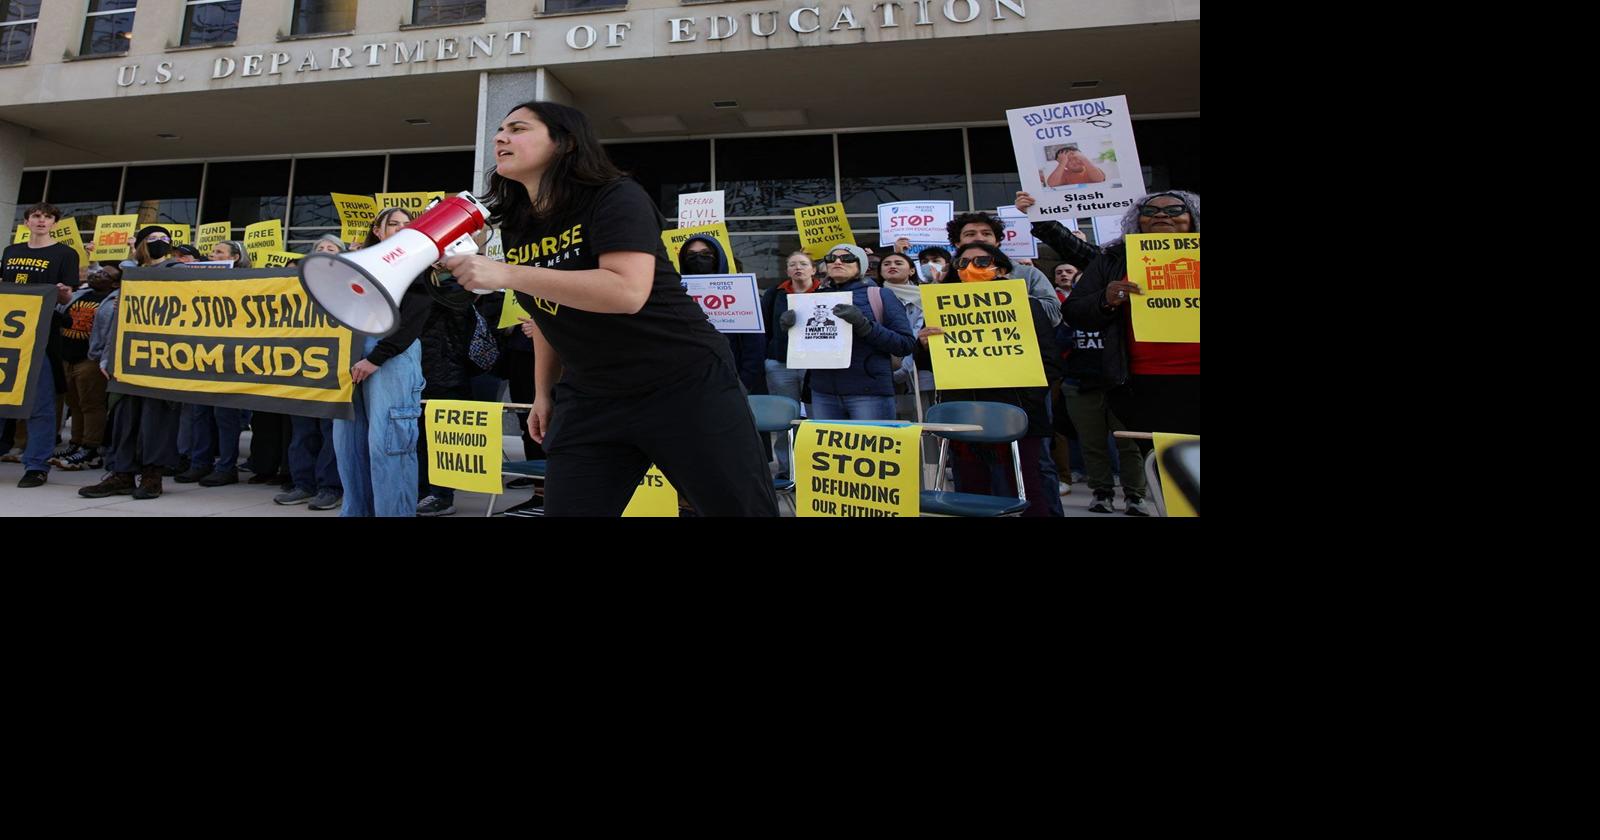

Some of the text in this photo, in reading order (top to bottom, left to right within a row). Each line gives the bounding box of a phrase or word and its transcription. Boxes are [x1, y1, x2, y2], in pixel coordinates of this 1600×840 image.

[117, 0, 1027, 88] U.S. DEPARTMENT OF EDUCATION
[1023, 100, 1106, 127] EDUCATION
[1035, 125, 1073, 140] CUTS
[382, 197, 422, 208] FUND
[1064, 191, 1104, 202] Slash
[1077, 198, 1134, 212] futures!
[343, 211, 375, 219] STOP
[680, 208, 718, 220] CIVIL
[800, 206, 836, 218] FUND
[803, 215, 840, 227] EDUCATION
[889, 215, 934, 228] STOP
[48, 227, 72, 239] REE
[201, 226, 226, 235] FUND
[248, 228, 275, 239] FREE
[805, 224, 843, 237] NOT 1%
[671, 234, 688, 243] KIDS
[807, 233, 846, 244] TAX CUTS
[1140, 239, 1171, 251] KIDS
[7, 257, 50, 269] SUNRISE
[534, 248, 581, 267] EMENT
[936, 291, 1013, 310] FUND
[1147, 297, 1181, 309] GOOD
[124, 294, 188, 328] TRUMP:
[192, 295, 239, 328] STOP
[940, 309, 1017, 328] EDUCATION
[943, 326, 1022, 345] NOT 1%
[1073, 329, 1101, 338] EW
[1074, 339, 1105, 349] EAL
[946, 344, 1024, 358] TAX CUTS
[128, 338, 330, 380] FROM KIDS
[434, 408, 489, 428] FREE
[434, 430, 487, 448] MAHMOUD
[815, 428, 902, 455] TRUMP:
[436, 450, 488, 475] KHALIL
[812, 451, 900, 480] STOP
[811, 476, 900, 506] DEFUNDING
[811, 498, 837, 516] OUR
